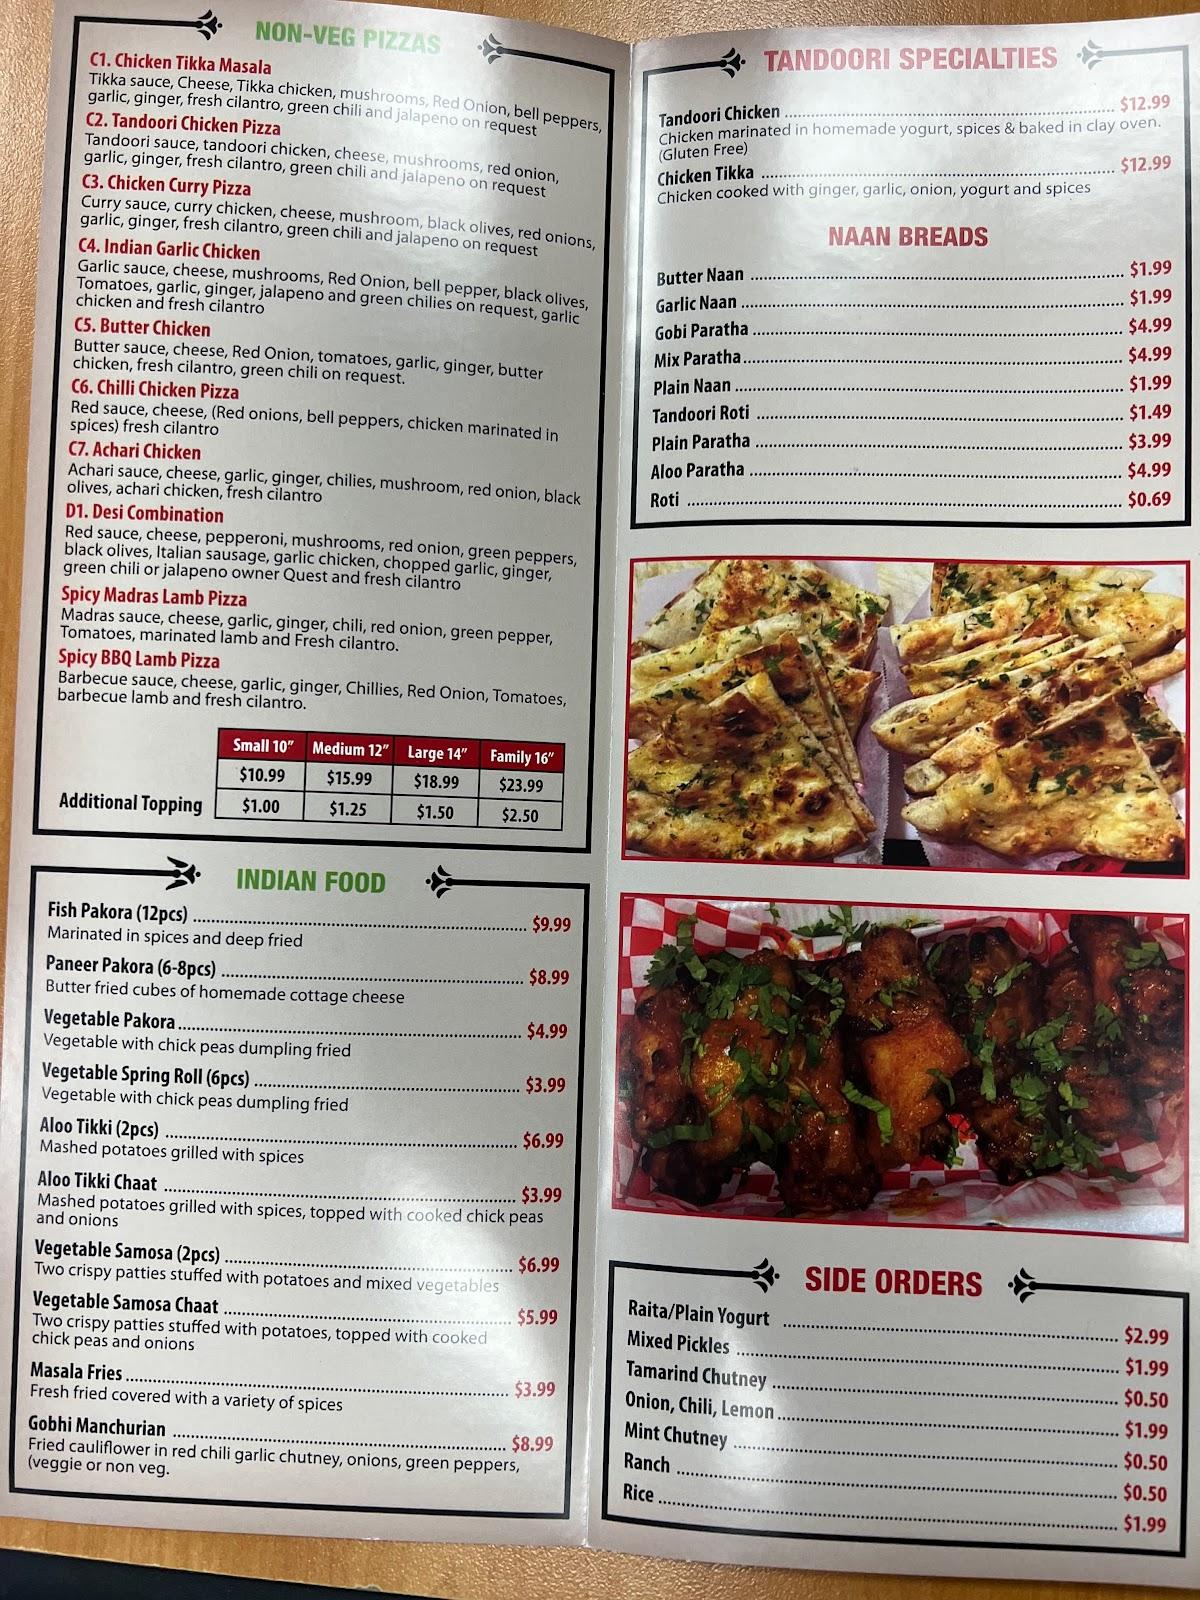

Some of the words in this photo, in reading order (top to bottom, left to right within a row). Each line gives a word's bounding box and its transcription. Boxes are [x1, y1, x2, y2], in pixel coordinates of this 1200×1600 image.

[256, 21, 355, 46] NON-VEG
[364, 29, 441, 54] PIZZAS
[90, 52, 111, 67] C1.
[115, 53, 171, 69] Chicken
[176, 55, 215, 71] Tikka
[219, 57, 271, 75] Masala
[764, 48, 890, 72] TANDOORI
[899, 47, 1057, 70] SPECIALTIES
[89, 72, 126, 86] Tikka
[130, 77, 173, 90] sauce,
[178, 76, 233, 93] Cheese,
[236, 79, 274, 93] Tikka
[278, 82, 336, 100] chicken,
[340, 88, 429, 108] mushrooms,
[433, 95, 459, 109] Red
[464, 99, 510, 118] Onion,
[514, 104, 539, 120] bell
[543, 112, 602, 134] peppers,
[659, 107, 721, 127] Tandoori
[724, 104, 780, 121] Chicken
[1120, 94, 1170, 113] $12.99
[659, 129, 713, 145] Chicken
[718, 123, 791, 140] marinated
[796, 126, 808, 135] in
[813, 122, 896, 135] homemade
[900, 124, 952, 138] yogurt,
[957, 123, 1000, 137] spices
[1005, 122, 1015, 134] &
[1019, 120, 1064, 134] baked
[1069, 120, 1082, 133] in
[1087, 119, 1115, 134] clay
[1120, 118, 1161, 130] oven.
[659, 147, 709, 163] (Gluten
[714, 141, 748, 156] Free)
[79, 237, 100, 253] C4.
[105, 238, 152, 255] Indian
[156, 241, 199, 257] Garlic
[202, 243, 260, 261] Chicken
[829, 226, 890, 246] NAAN
[899, 227, 988, 247] BREADS
[78, 259, 119, 273] Garlic
[124, 264, 169, 277] sauce,
[173, 263, 228, 280] cheese,
[232, 267, 324, 285] mushrooms,
[328, 271, 356, 286] Red
[360, 274, 409, 291] Onion,
[414, 277, 440, 292] bell
[445, 284, 500, 300] pepper,
[504, 285, 542, 303] black
[545, 292, 588, 311] olives,
[657, 271, 703, 286] Butter
[707, 267, 744, 282] Naan
[1130, 260, 1172, 278] $1.99
[74, 317, 96, 332] C5.
[100, 318, 150, 334] Butter
[153, 320, 210, 337] Chicken
[655, 324, 687, 340] Gobi
[691, 321, 748, 338] Paratha
[1129, 317, 1172, 336] $4.99
[652, 405, 716, 424] Tandoori
[720, 404, 749, 420] Roti
[1130, 404, 1172, 422] $1.49
[69, 441, 89, 456] C7.
[92, 441, 139, 458] Achari
[143, 443, 201, 460] Chicken
[66, 503, 88, 518] D1.
[93, 503, 123, 520] Desi
[127, 504, 224, 523] Combination
[650, 491, 679, 508] Roti
[1128, 491, 1171, 509] $0.69
[66, 525, 93, 539] Red
[97, 529, 142, 542] sauce,
[146, 527, 201, 544] cheese,
[206, 532, 287, 548] pepperoni,
[292, 534, 384, 552] mushrooms,
[389, 539, 413, 552] red
[417, 541, 464, 558] onion,
[468, 547, 510, 560] green
[515, 550, 577, 568] peppers,
[59, 648, 97, 669] Spicy
[101, 649, 132, 667] BBQ
[136, 650, 177, 667] Lamb
[181, 652, 220, 669] Pizza
[233, 738, 269, 753] Small
[312, 742, 365, 757] Medium
[408, 745, 444, 761] Large
[491, 749, 532, 767] Family
[240, 766, 285, 783] $10.99
[327, 769, 372, 786] $15.99
[414, 773, 459, 790] $18.99
[499, 776, 543, 793] $23.99
[59, 792, 138, 810] Additional
[141, 795, 202, 817] Topping
[242, 797, 280, 814] $1.00
[330, 800, 366, 817] $1.25
[417, 803, 454, 820] $1.50
[502, 807, 539, 823] $2.50
[237, 868, 316, 891] INDIAN
[325, 871, 386, 893] FOOD
[48, 901, 77, 918] Fish
[81, 902, 132, 920] Pakora
[136, 904, 188, 925] (12pcs)
[532, 915, 571, 934] $9.99
[48, 925, 122, 941] Marinated
[127, 928, 139, 942] in
[144, 930, 189, 946] spices
[193, 931, 221, 945] and
[225, 931, 264, 950] deep
[268, 932, 303, 947] fried
[46, 954, 99, 972] Paneer
[102, 957, 153, 974] Pakora
[158, 958, 216, 980] (6-8pcs)
[529, 968, 569, 987] $8.99
[42, 1062, 118, 1083] Vegetable
[121, 1065, 170, 1087] Spring
[174, 1068, 202, 1084] Roll
[206, 1068, 249, 1090] (6pcs)
[526, 1075, 566, 1095] $3.99
[37, 1170, 70, 1187] Aloo
[74, 1172, 110, 1189] Tikki
[114, 1174, 157, 1191] Chaat
[522, 1186, 562, 1205] $3.99
[35, 1239, 111, 1260] Vegetable
[115, 1242, 173, 1260] Samosa
[177, 1244, 220, 1266] (2pcs)
[519, 1256, 560, 1274] $6.99
[805, 1266, 866, 1293] SIDE
[875, 1268, 982, 1297] ORDERS
[629, 1299, 714, 1323] Raita/Plain
[717, 1307, 770, 1329] Yogurt
[1125, 1325, 1169, 1345] $2.99
[30, 1361, 83, 1379] Masala
[87, 1364, 122, 1381] Fries
[515, 1380, 555, 1399] $3.99
[626, 1360, 698, 1383] Tamarind
[702, 1367, 767, 1392] Chutney
[1124, 1388, 1168, 1408] $0.50
[30, 1384, 69, 1398] Fresh
[73, 1385, 107, 1400] fried
[112, 1389, 171, 1403] covered
[175, 1391, 207, 1405] with
[212, 1395, 219, 1405] a
[224, 1394, 275, 1412] variety
[279, 1395, 295, 1409] of
[298, 1397, 343, 1413] spices
[626, 1390, 675, 1414] Onion,
[679, 1396, 717, 1418] Chili,
[722, 1400, 774, 1419] Lemon
[1125, 1420, 1168, 1440] $1.99
[28, 1415, 72, 1432] Gobhi
[76, 1417, 165, 1437] Manchurian
[512, 1434, 553, 1453] $8.99
[623, 1483, 654, 1503] Rice
[1124, 1514, 1166, 1533] $1.99
